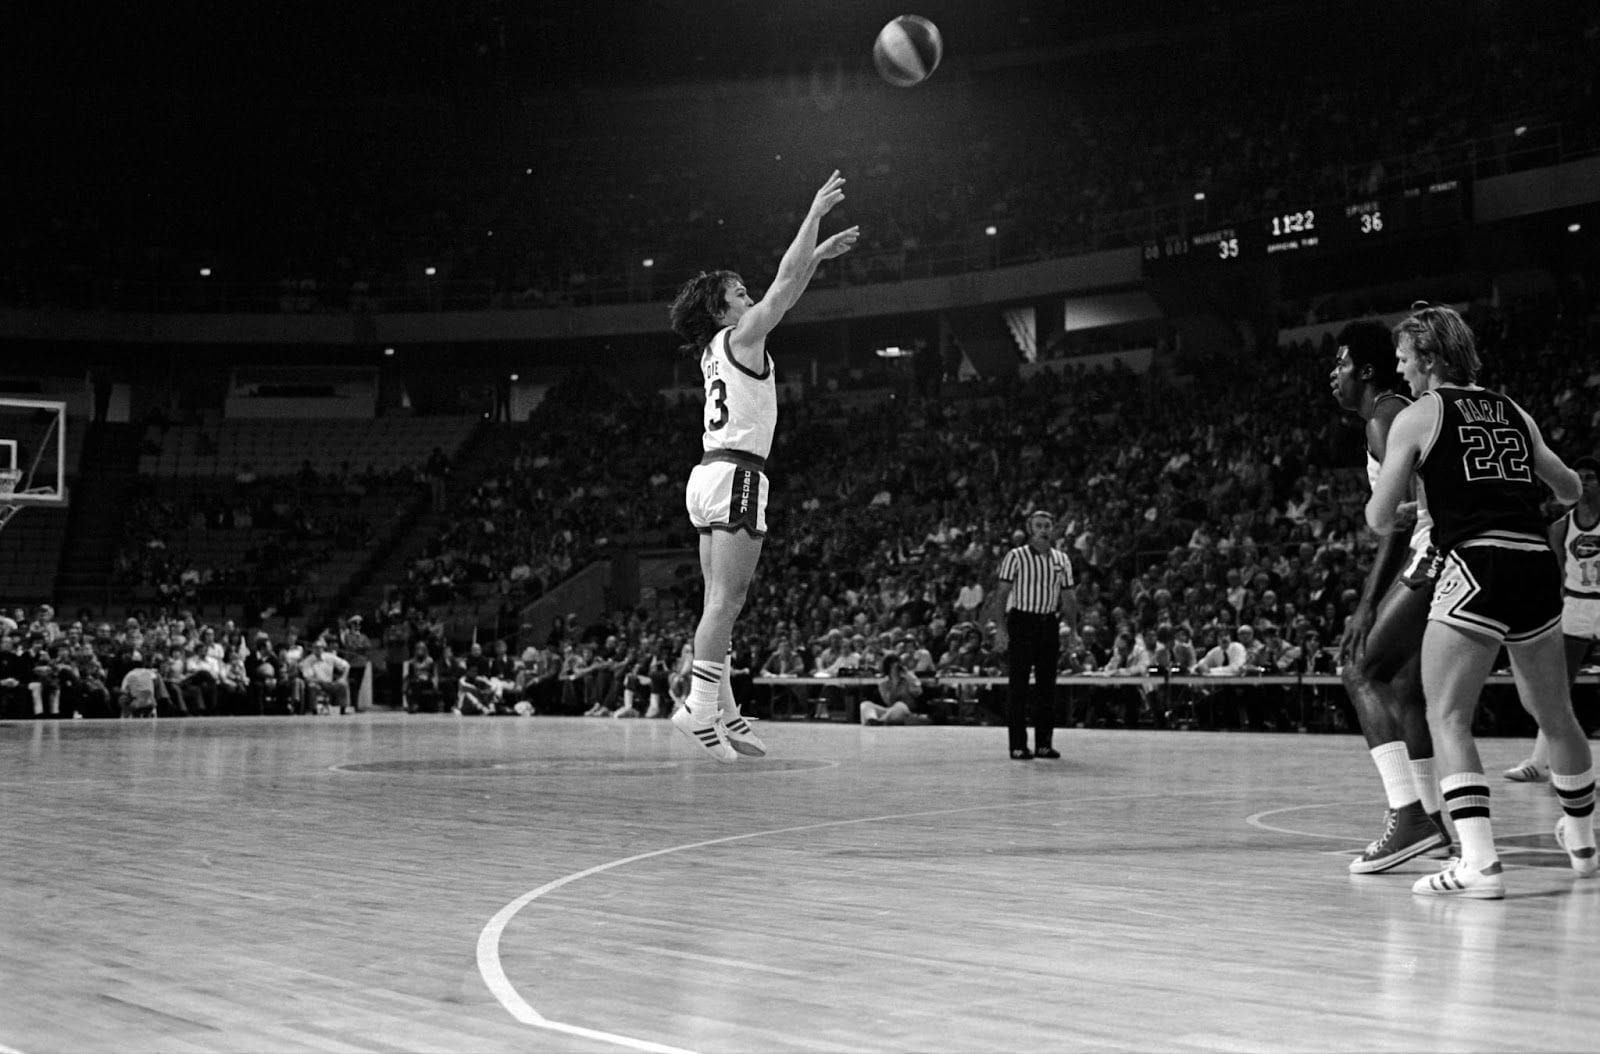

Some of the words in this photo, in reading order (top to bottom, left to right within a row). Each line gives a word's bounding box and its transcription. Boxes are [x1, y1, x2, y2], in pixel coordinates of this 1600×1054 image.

[1360, 211, 1384, 234] 36
[1218, 238, 1240, 260] 35
[1458, 426, 1532, 482] 22
